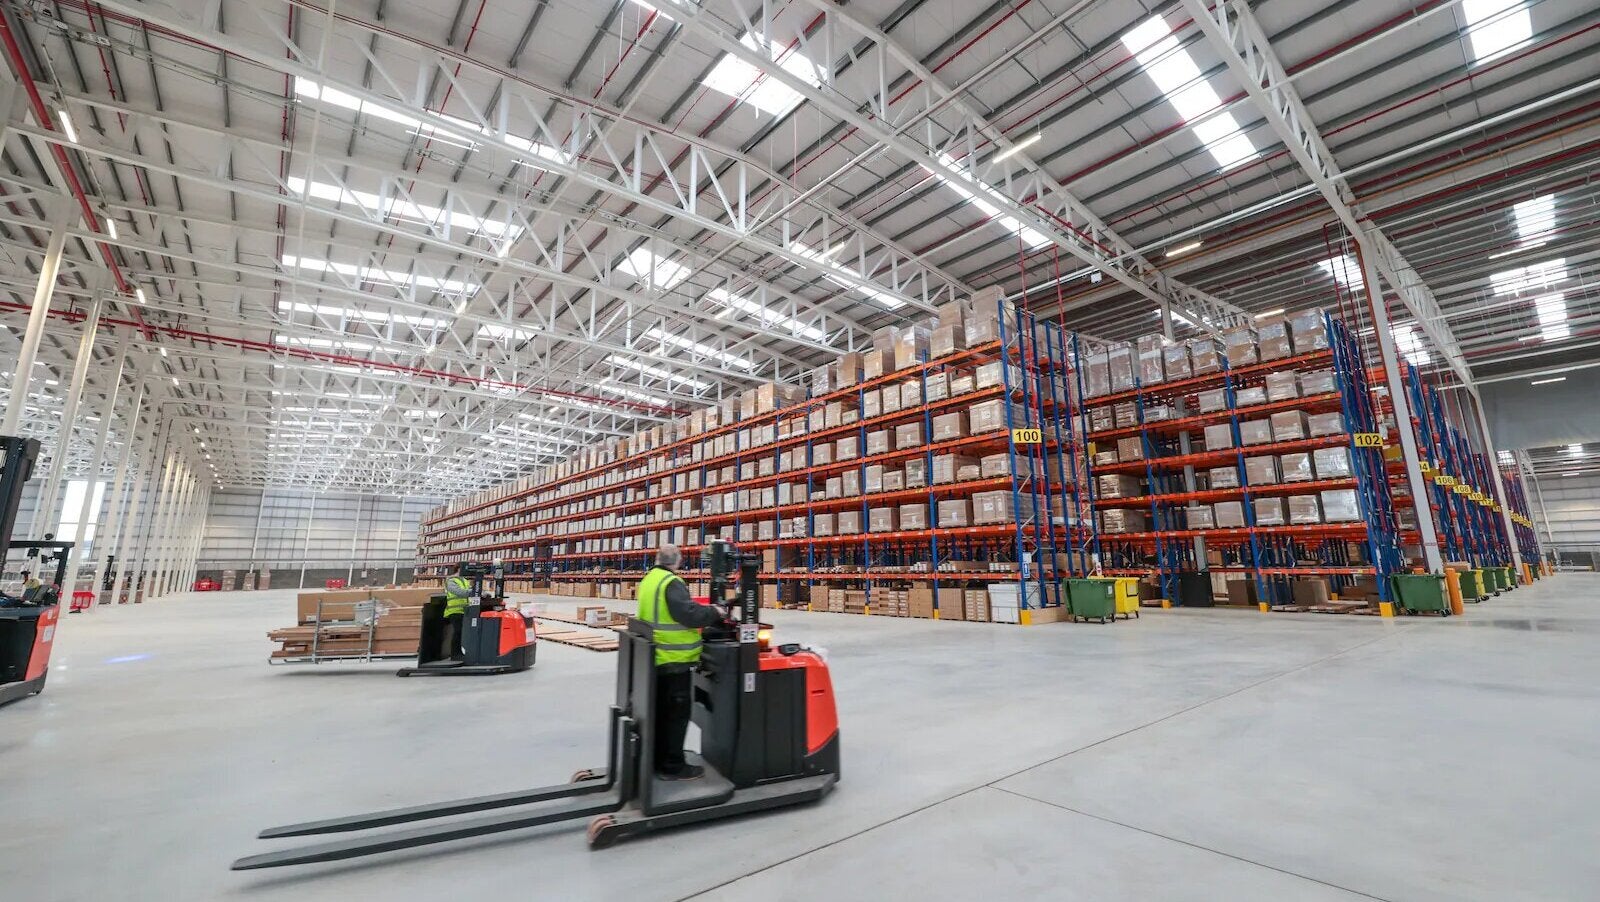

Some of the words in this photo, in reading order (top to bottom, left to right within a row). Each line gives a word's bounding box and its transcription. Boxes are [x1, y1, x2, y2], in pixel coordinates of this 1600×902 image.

[1015, 430, 1039, 442] 100
[1356, 434, 1381, 446] 102
[1437, 476, 1453, 484] 106
[1455, 485, 1470, 493] 108
